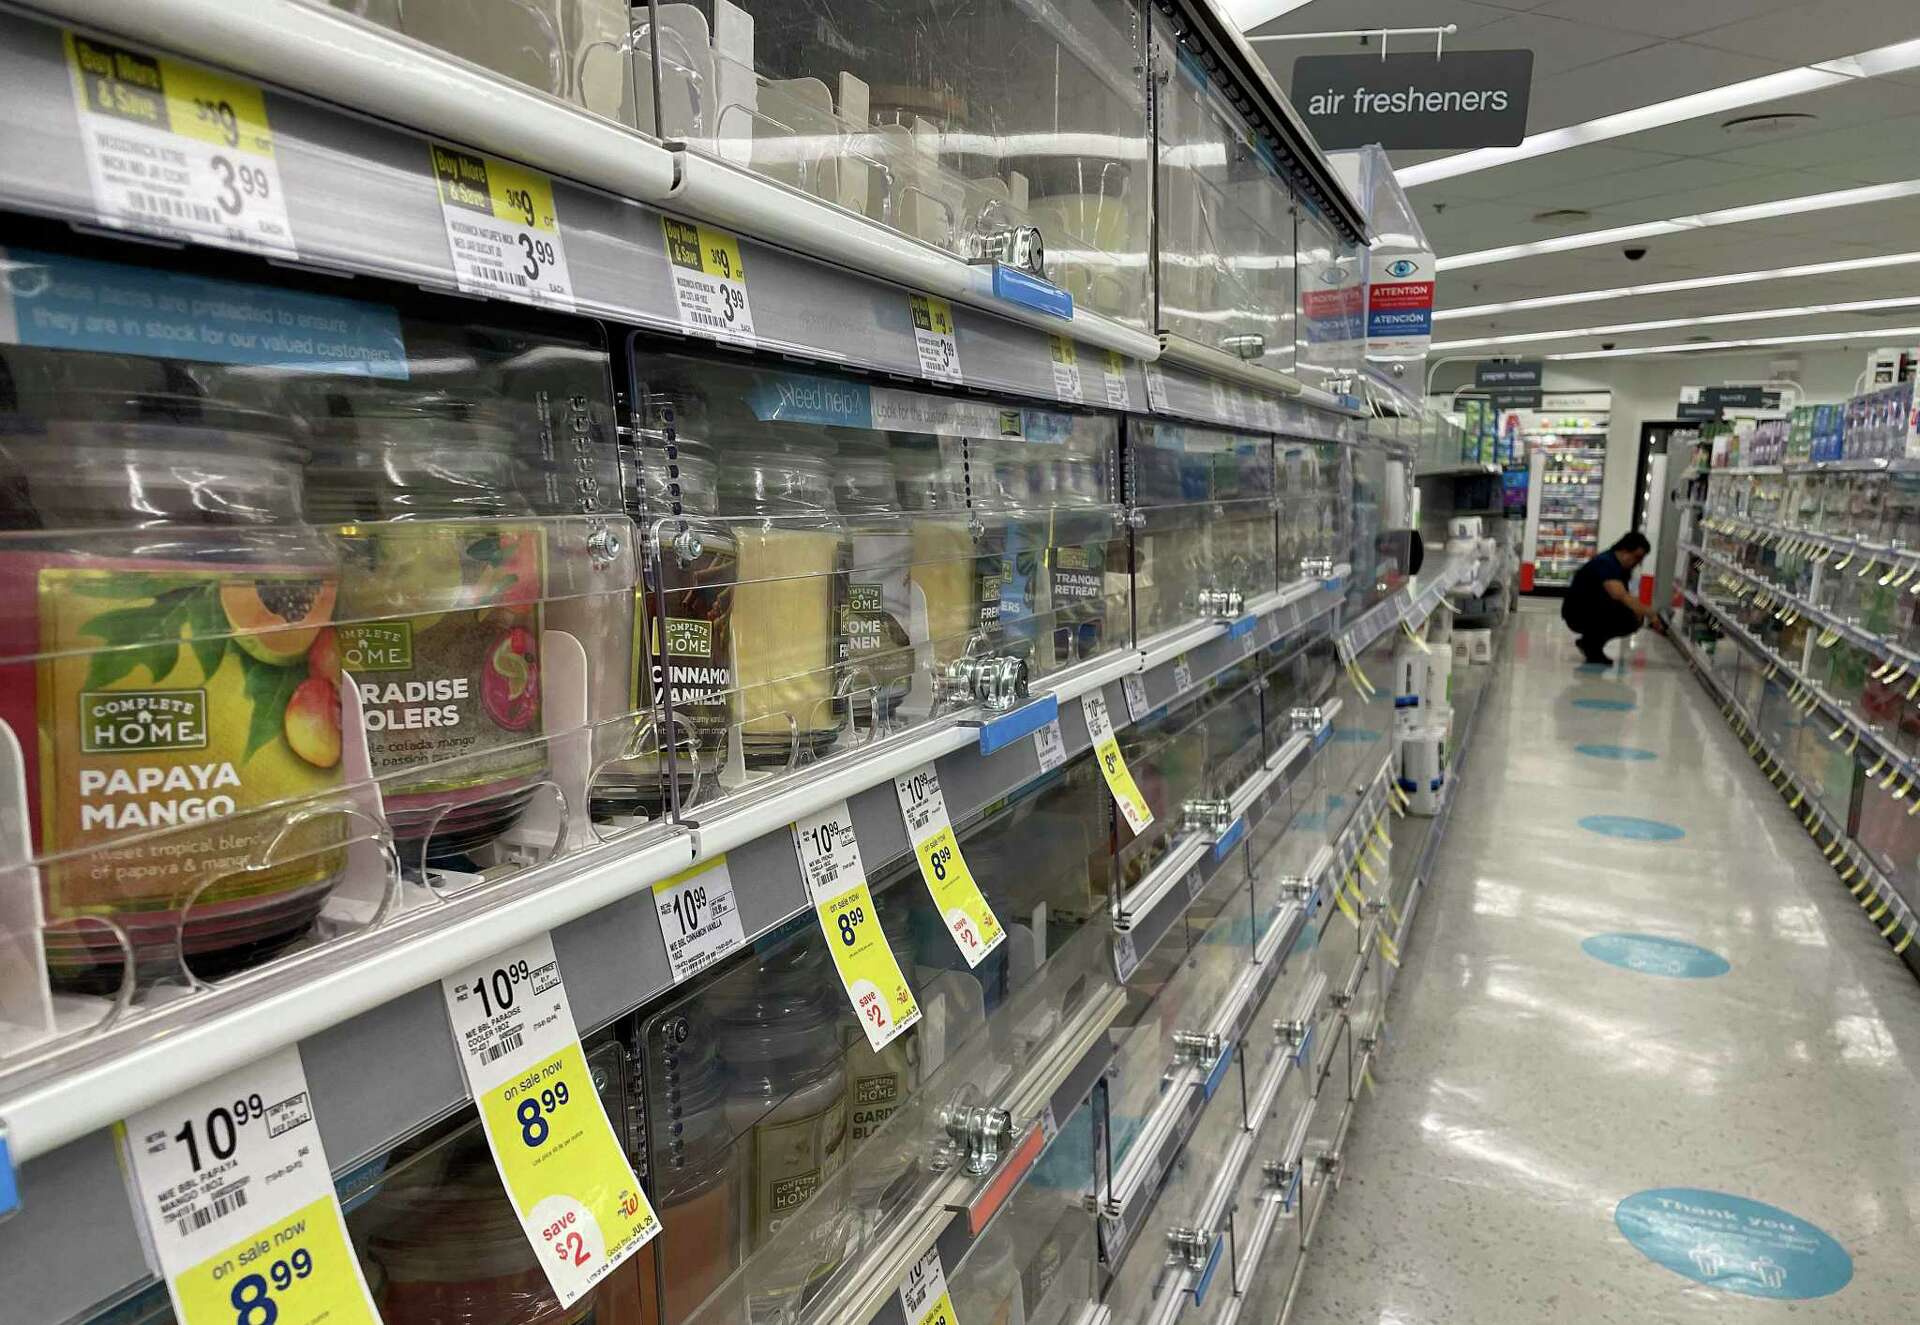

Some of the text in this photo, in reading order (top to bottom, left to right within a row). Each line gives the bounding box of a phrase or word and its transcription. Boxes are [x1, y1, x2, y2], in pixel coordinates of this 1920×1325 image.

[1308, 86, 1509, 115] air fresheners
[1373, 286, 1427, 296] ATTENTION
[277, 307, 293, 326] to
[1374, 313, 1424, 324] ATENCIÓN
[85, 319, 118, 336] are
[121, 317, 141, 337] in
[144, 320, 198, 343] stock
[200, 325, 228, 347] for
[230, 331, 259, 349] our
[262, 331, 314, 356] valued
[780, 383, 821, 410] Need
[1054, 584, 1097, 596] RETREAT
[851, 599, 881, 610] OME
[340, 629, 401, 642] MPLETE
[848, 620, 881, 634] OME
[849, 635, 881, 650] NEN
[346, 649, 403, 664] OME
[360, 678, 469, 704] RADISE
[91, 698, 194, 718] COMPLETE
[364, 705, 460, 731] OLERS
[94, 721, 195, 746] HOME
[79, 762, 242, 797] PAPAYA
[80, 795, 236, 831] MANGO
[152, 837, 214, 857] tropical
[115, 862, 180, 882] papaya
[961, 930, 977, 949] $2
[858, 990, 877, 1008] save
[491, 1006, 521, 1027] PARADISE
[866, 1004, 886, 1028] $2
[468, 1029, 494, 1048] COOLER
[504, 1059, 563, 1102] on sale now
[860, 1088, 895, 1101] HOME
[853, 1106, 900, 1124] GARD
[200, 1159, 239, 1184] PAPAYA
[160, 1188, 199, 1214] MANGO
[542, 1210, 577, 1241] save
[632, 1223, 647, 1237] JUL
[646, 1214, 654, 1226] 29
[1655, 1196, 1796, 1234] Thank you
[212, 1219, 306, 1281] on sale now
[555, 1231, 592, 1267] $2
